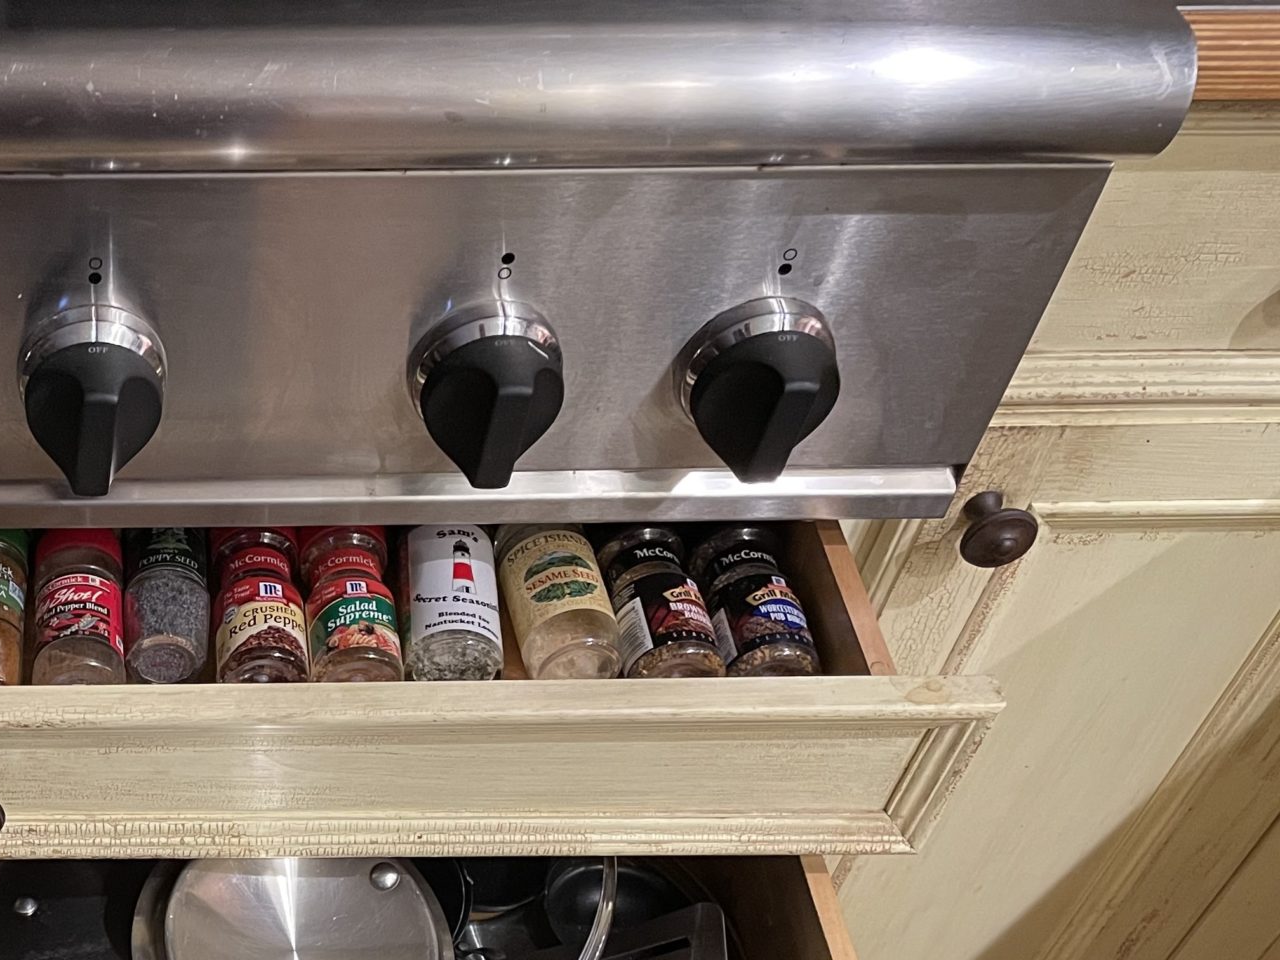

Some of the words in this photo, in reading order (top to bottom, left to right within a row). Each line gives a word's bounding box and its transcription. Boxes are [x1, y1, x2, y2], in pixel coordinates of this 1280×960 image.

[436, 529, 479, 543] Sam's
[507, 536, 542, 568] SPICE
[138, 553, 175, 569] POPPY
[175, 555, 199, 570] SEED
[230, 554, 289, 573] McCormick
[525, 570, 571, 594] SESAME
[571, 569, 600, 584] SEED
[413, 593, 449, 603] Secret
[669, 590, 694, 599] Grill
[752, 589, 778, 602] Grill
[56, 602, 85, 613] Pepper
[85, 602, 108, 616] Blend
[243, 605, 297, 617] CRUSHED
[338, 600, 378, 616] Salad
[229, 615, 257, 639] Red
[263, 613, 305, 633] Peppe
[327, 610, 390, 632] Supreme
[424, 618, 476, 630] Nantucket
